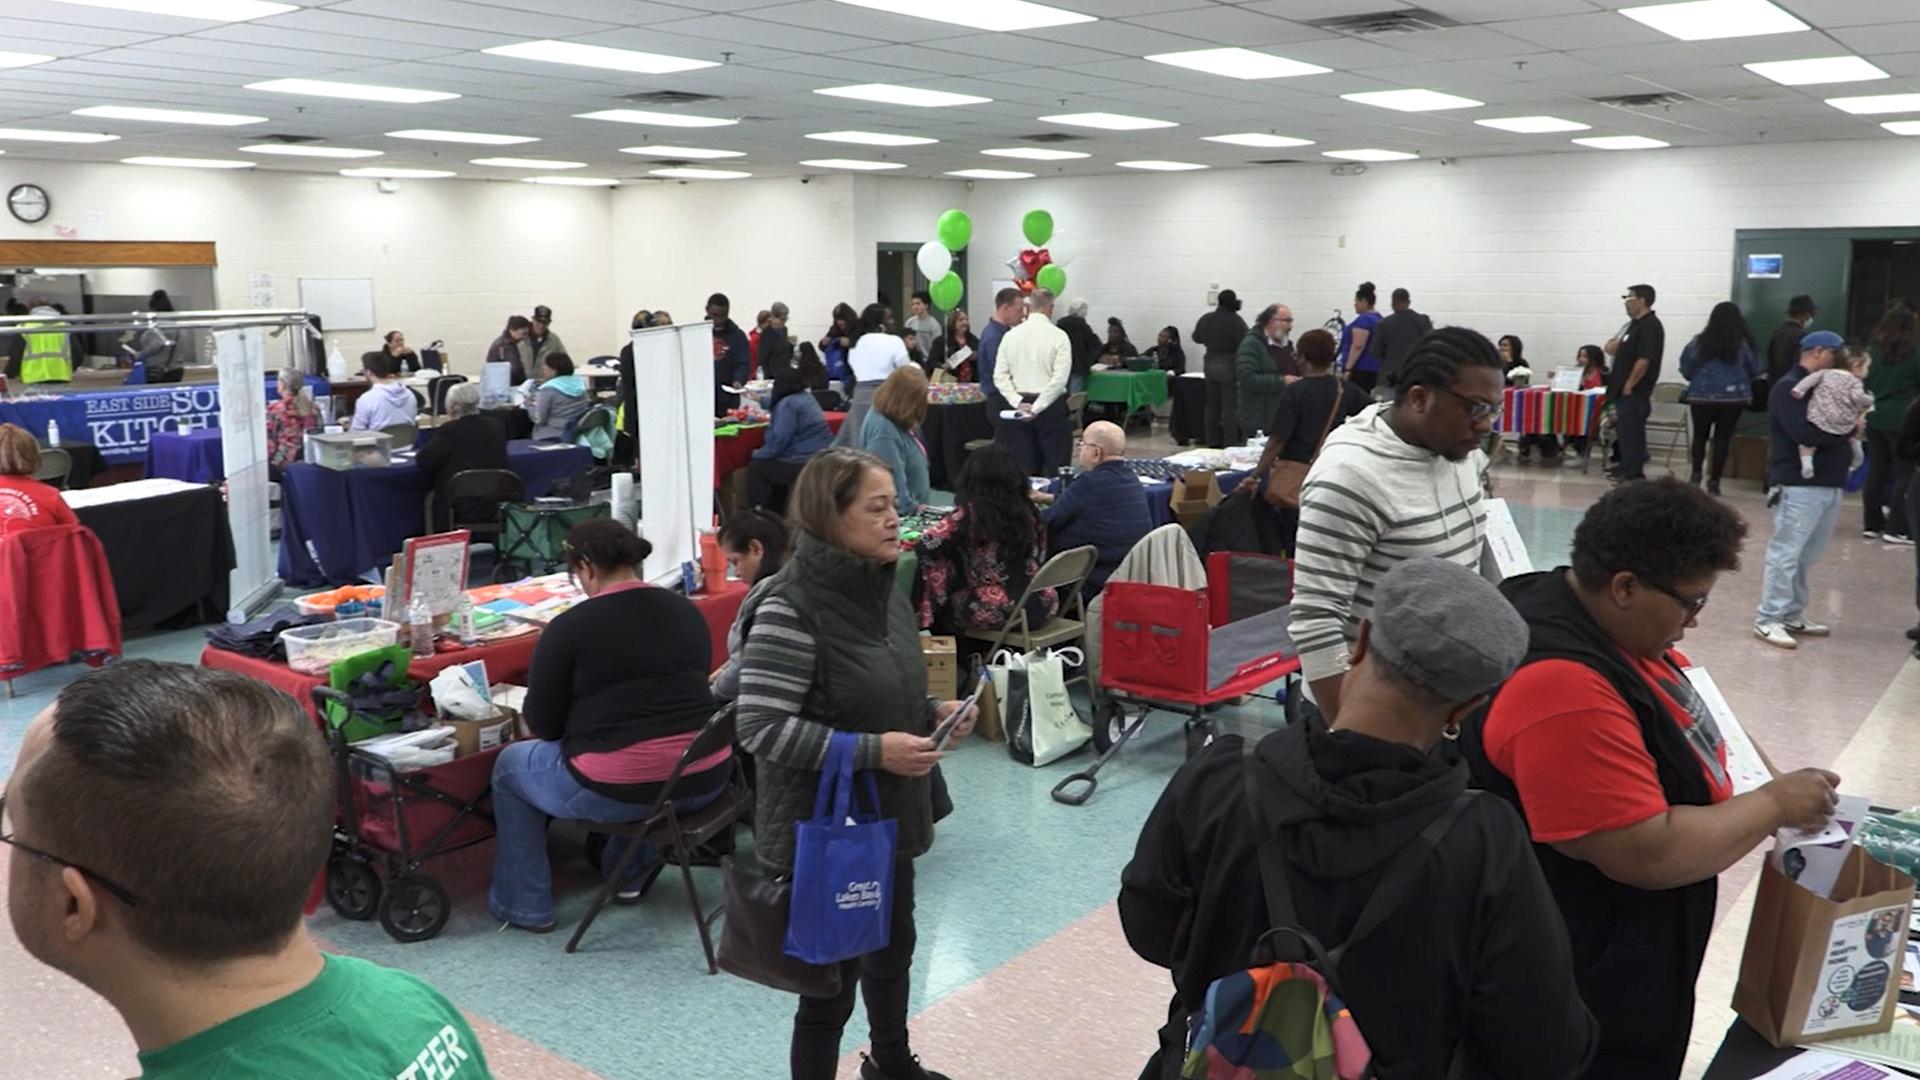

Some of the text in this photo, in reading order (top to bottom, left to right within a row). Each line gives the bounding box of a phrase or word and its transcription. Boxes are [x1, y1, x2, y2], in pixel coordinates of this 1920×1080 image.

[86, 390, 220, 413] EAST SIDE SO
